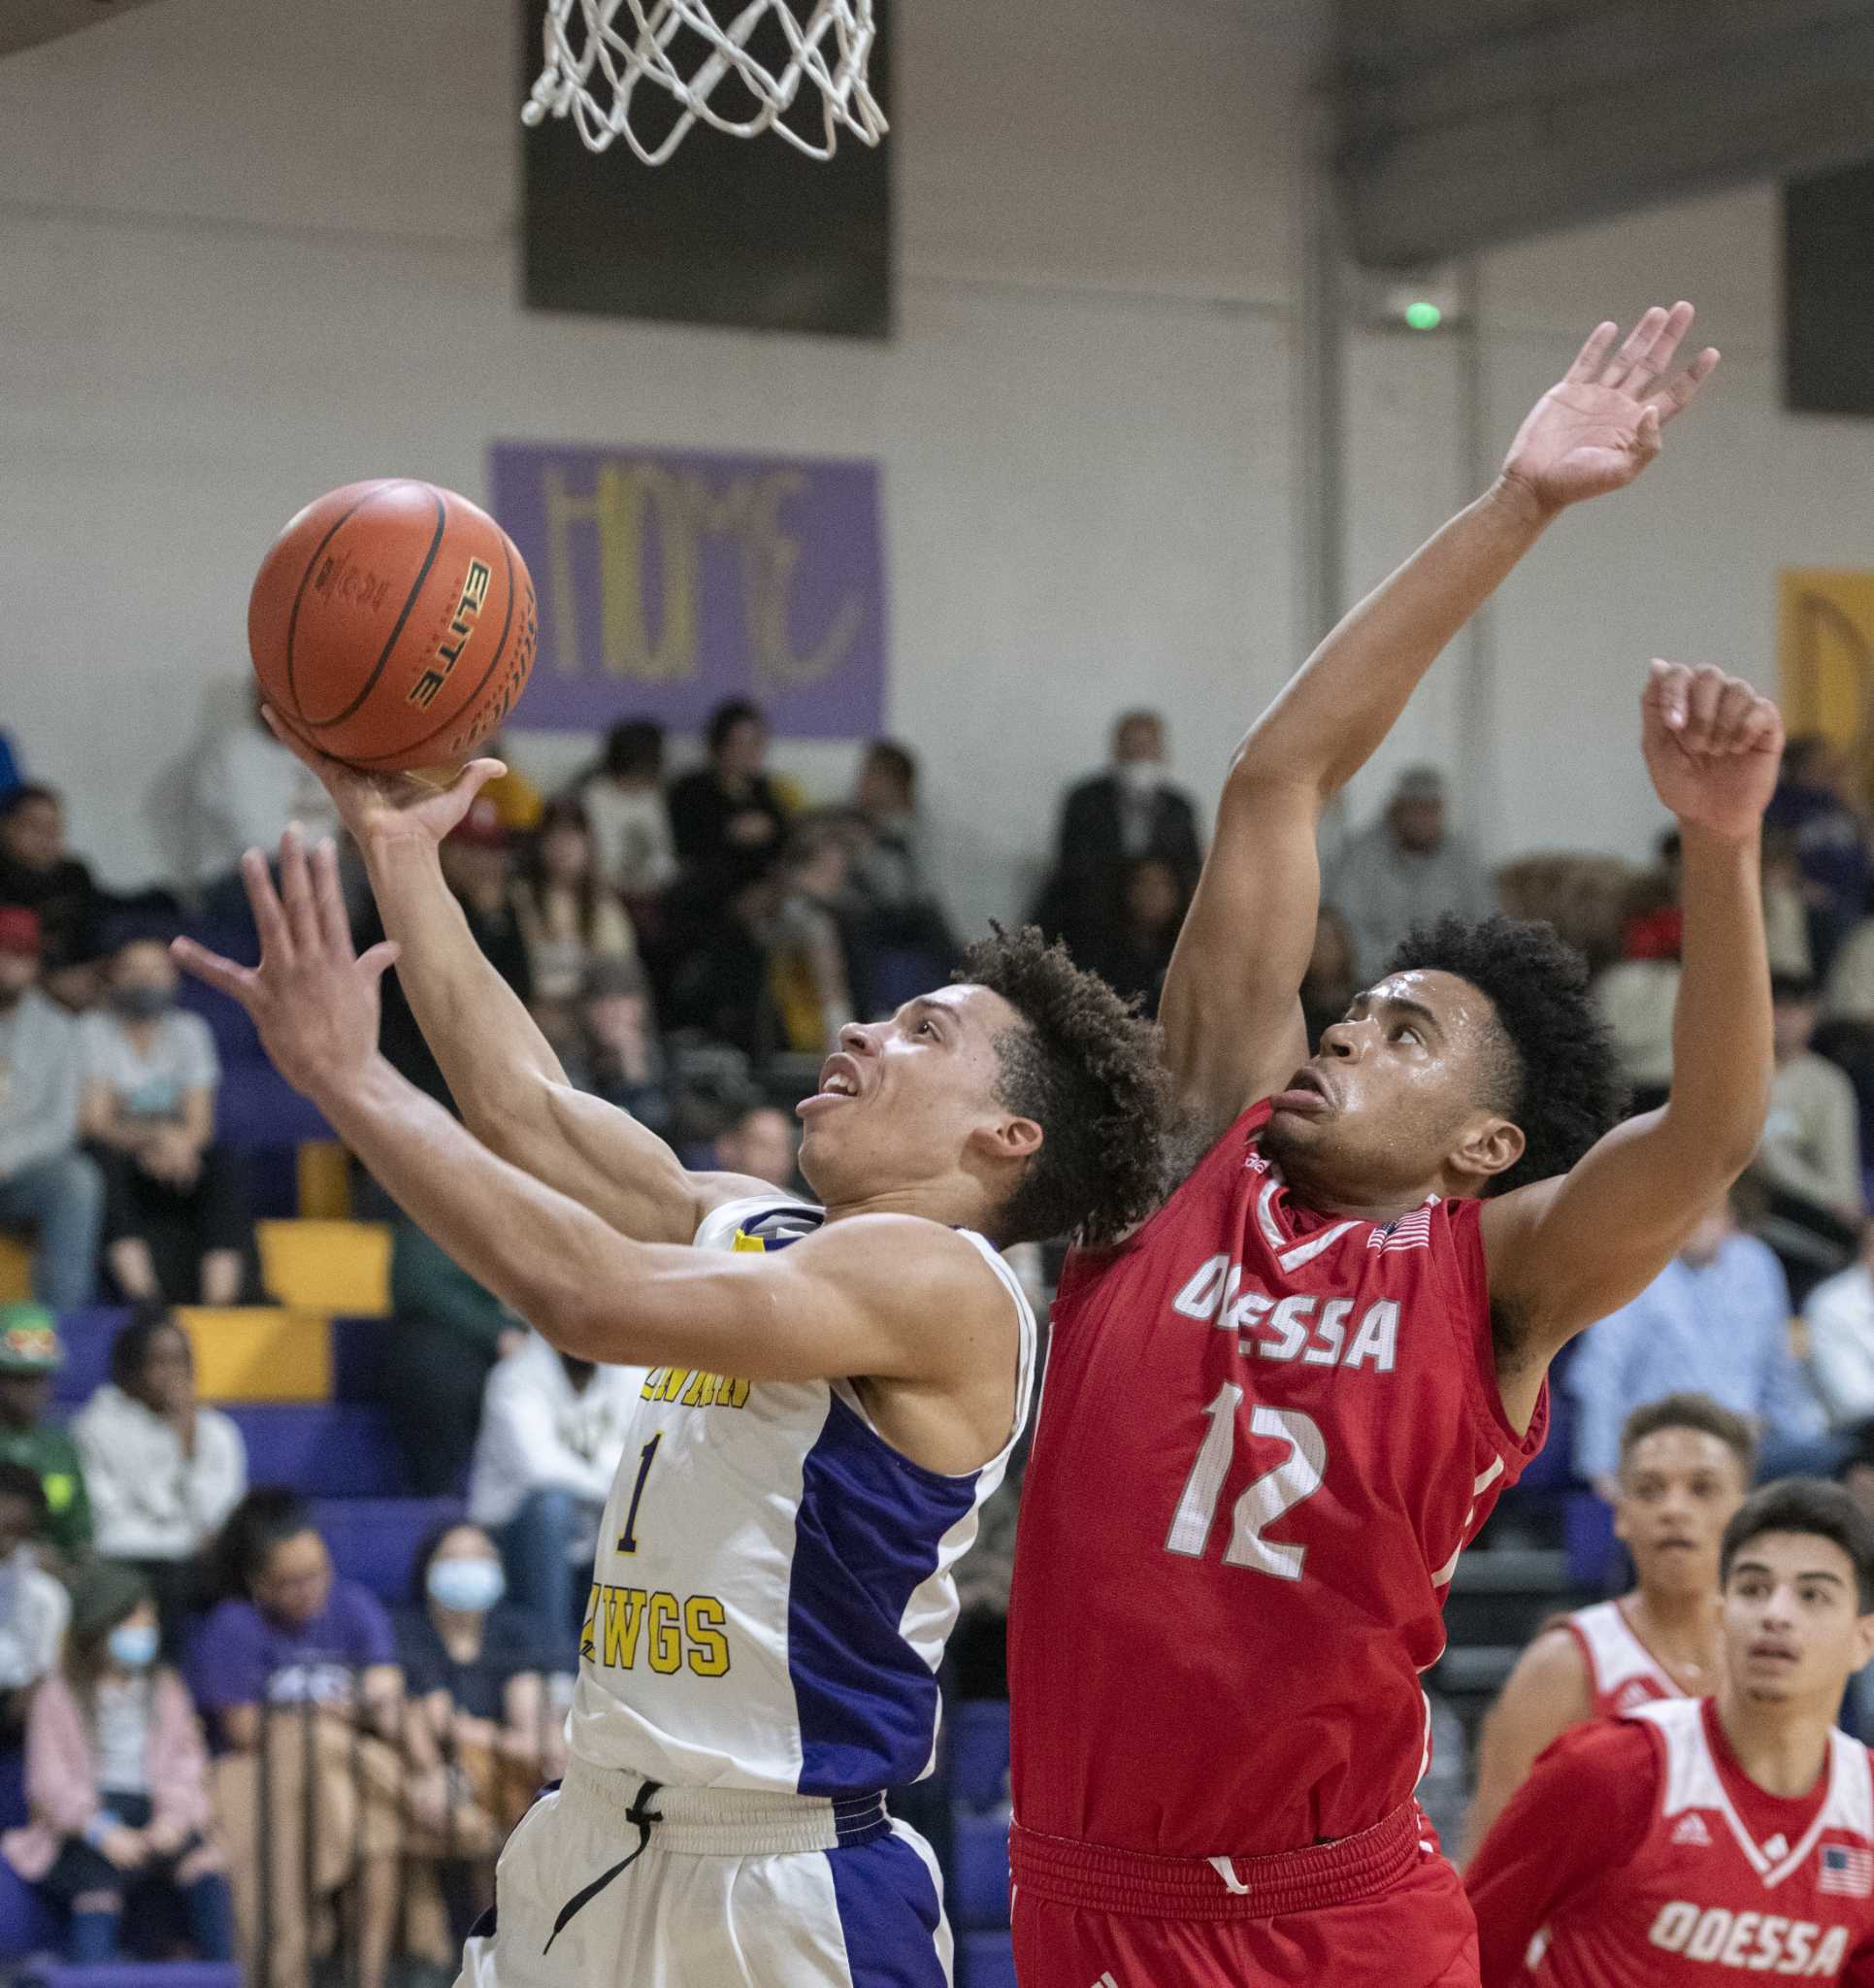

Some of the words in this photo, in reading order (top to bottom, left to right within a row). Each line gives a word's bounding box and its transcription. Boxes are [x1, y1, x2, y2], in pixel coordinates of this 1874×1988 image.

[405, 556, 491, 712] ELITE
[615, 1430, 664, 1554] 1
[1165, 1381, 1328, 1582] 12
[1650, 1900, 1849, 1976] ODESSA
